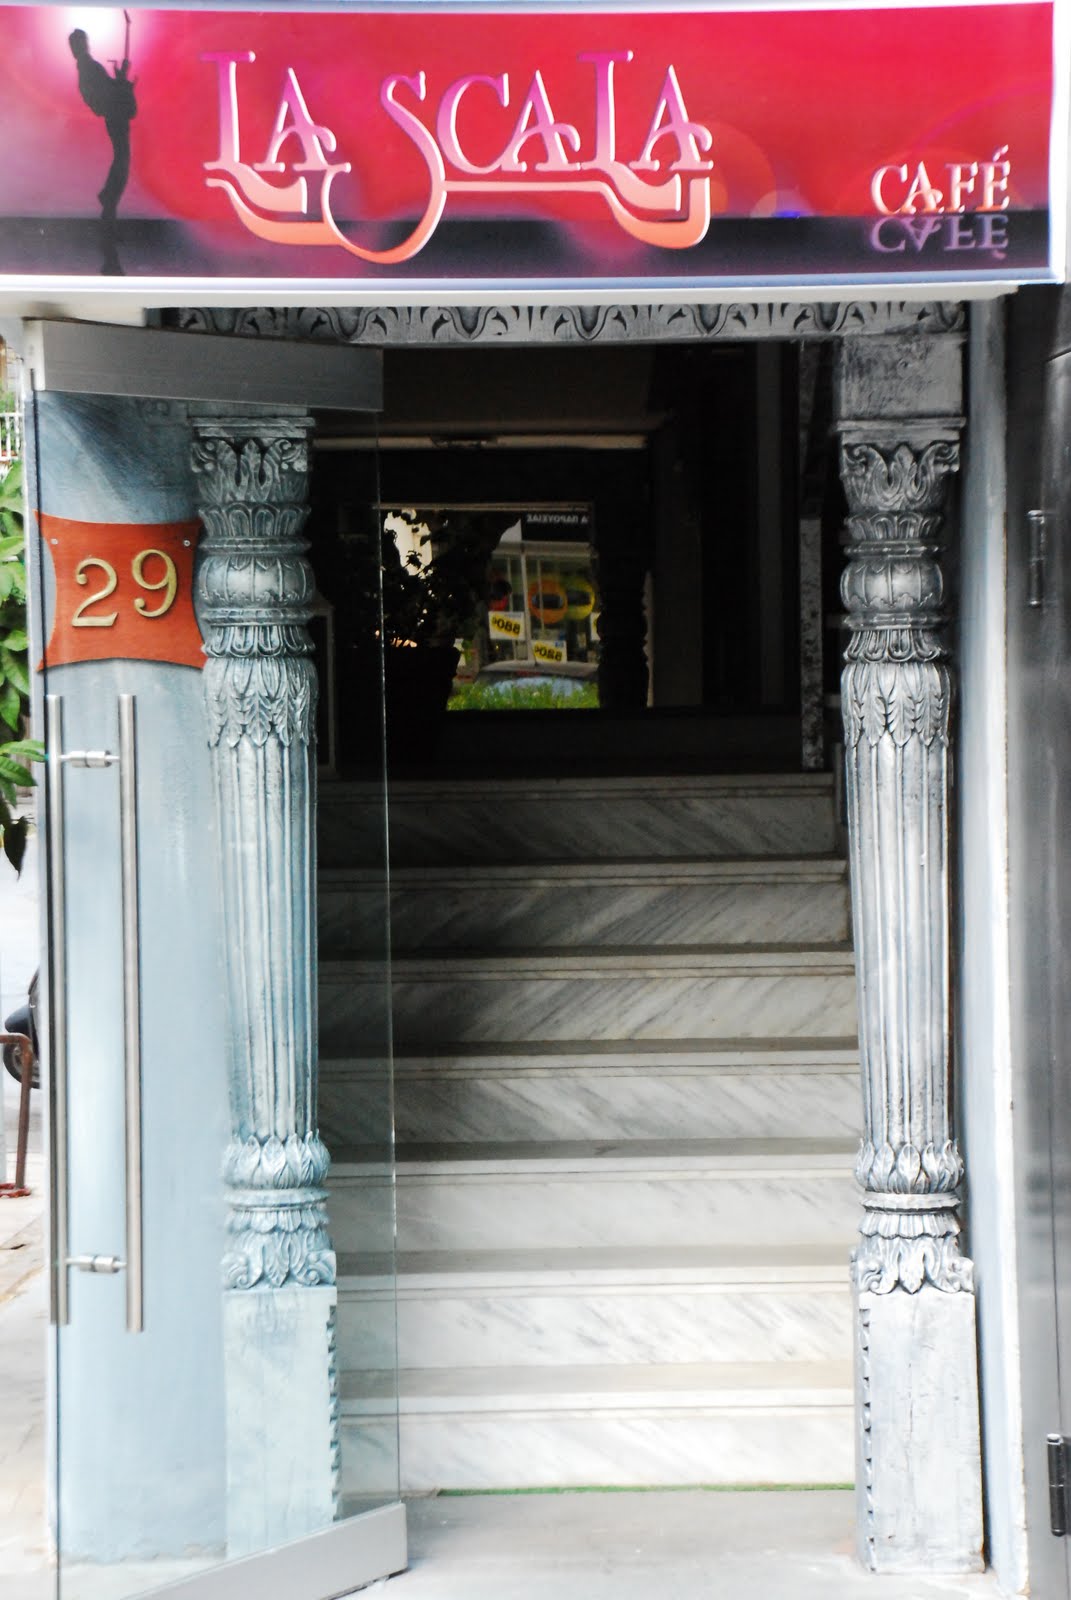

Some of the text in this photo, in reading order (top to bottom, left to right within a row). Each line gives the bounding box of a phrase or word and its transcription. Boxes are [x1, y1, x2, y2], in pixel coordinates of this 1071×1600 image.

[201, 50, 715, 263] LA SCALA
[870, 144, 1012, 215] CAFÉ
[71, 548, 178, 627] 29
